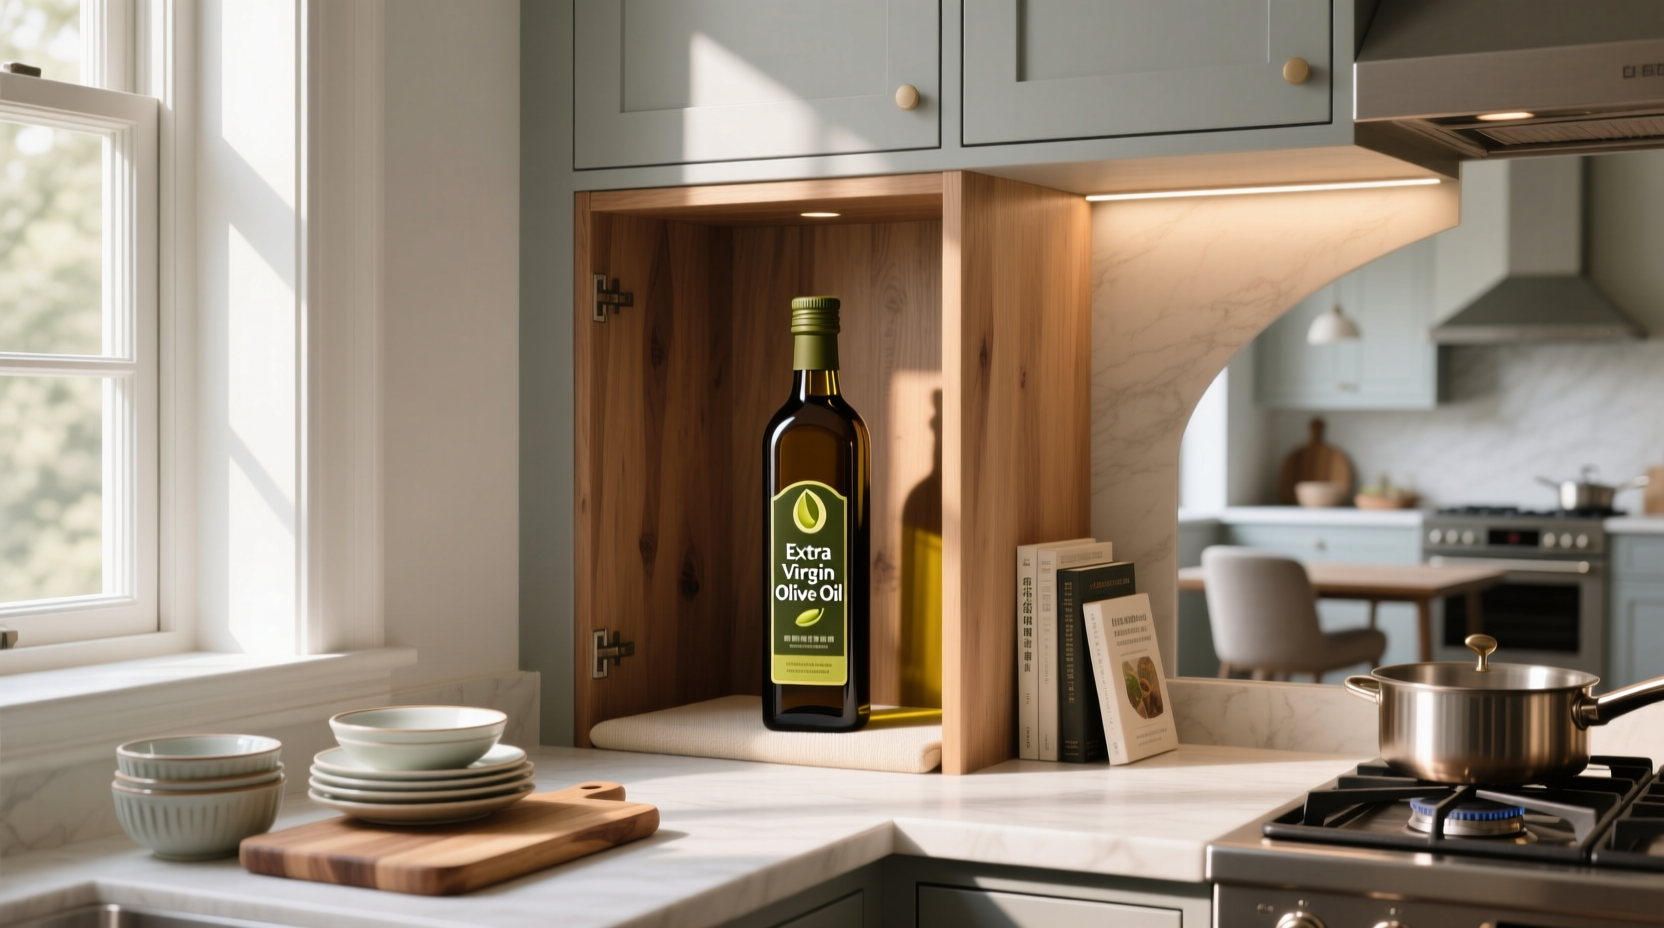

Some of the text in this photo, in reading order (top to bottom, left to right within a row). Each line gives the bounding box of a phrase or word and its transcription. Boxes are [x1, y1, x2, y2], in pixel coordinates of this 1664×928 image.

[786, 543, 831, 560] Extra
[782, 564, 834, 585] Virgin
[776, 584, 842, 601] Olive Oil
